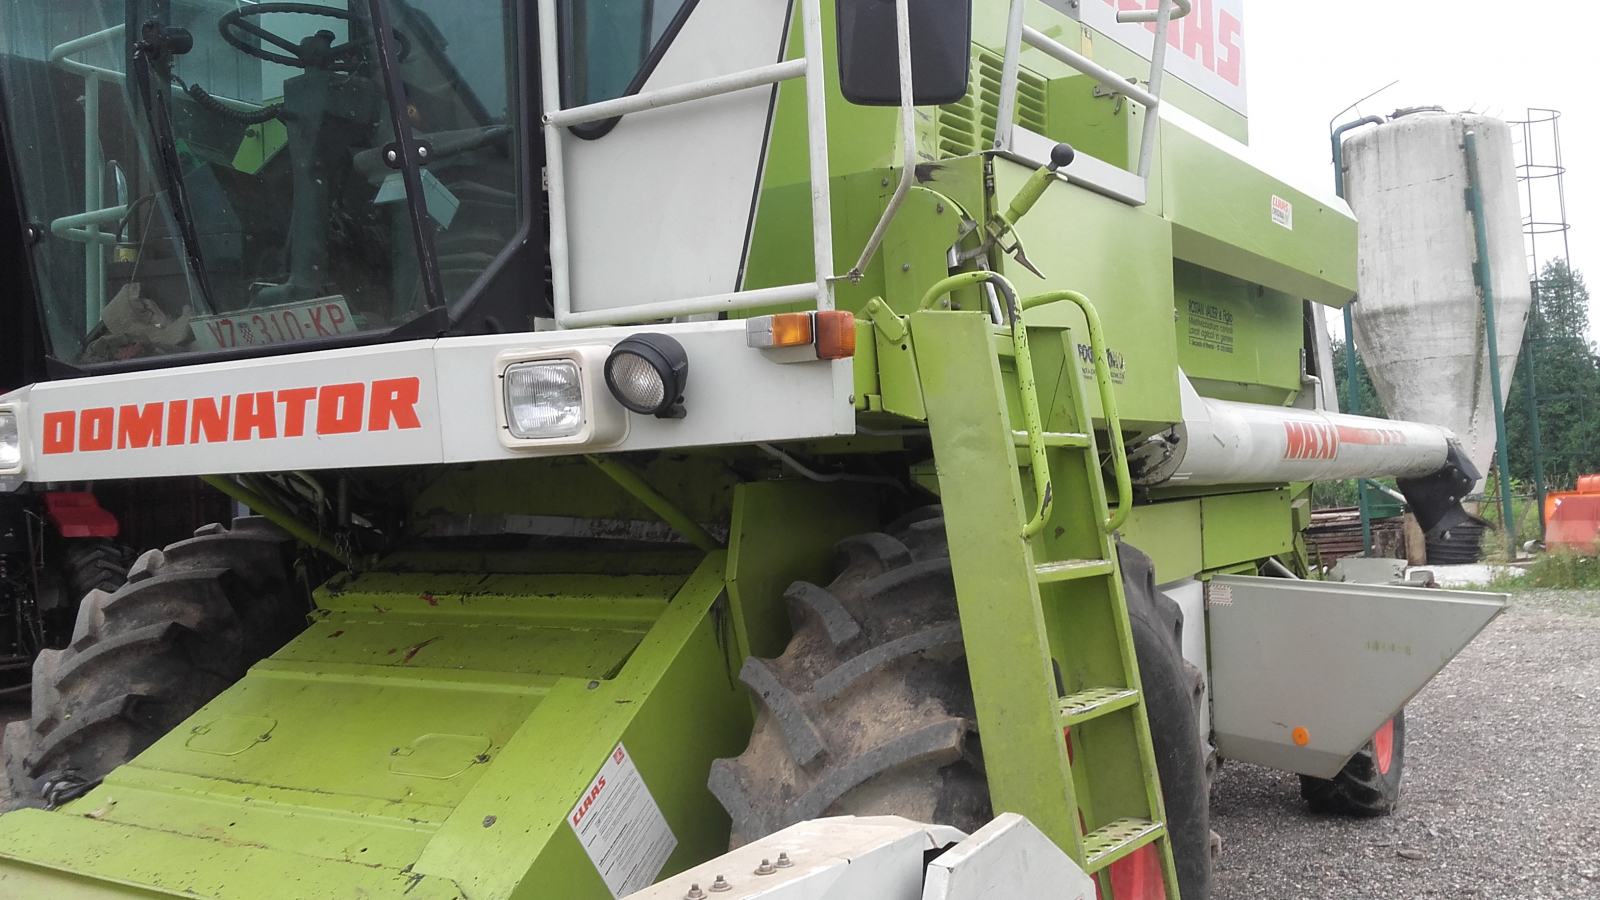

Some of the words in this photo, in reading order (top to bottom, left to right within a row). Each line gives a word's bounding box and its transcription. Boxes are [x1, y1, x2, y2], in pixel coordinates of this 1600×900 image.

[42, 376, 422, 455] DOMINATOR
[1283, 421, 1338, 460] MAXI
[572, 775, 606, 828] CLAAS
